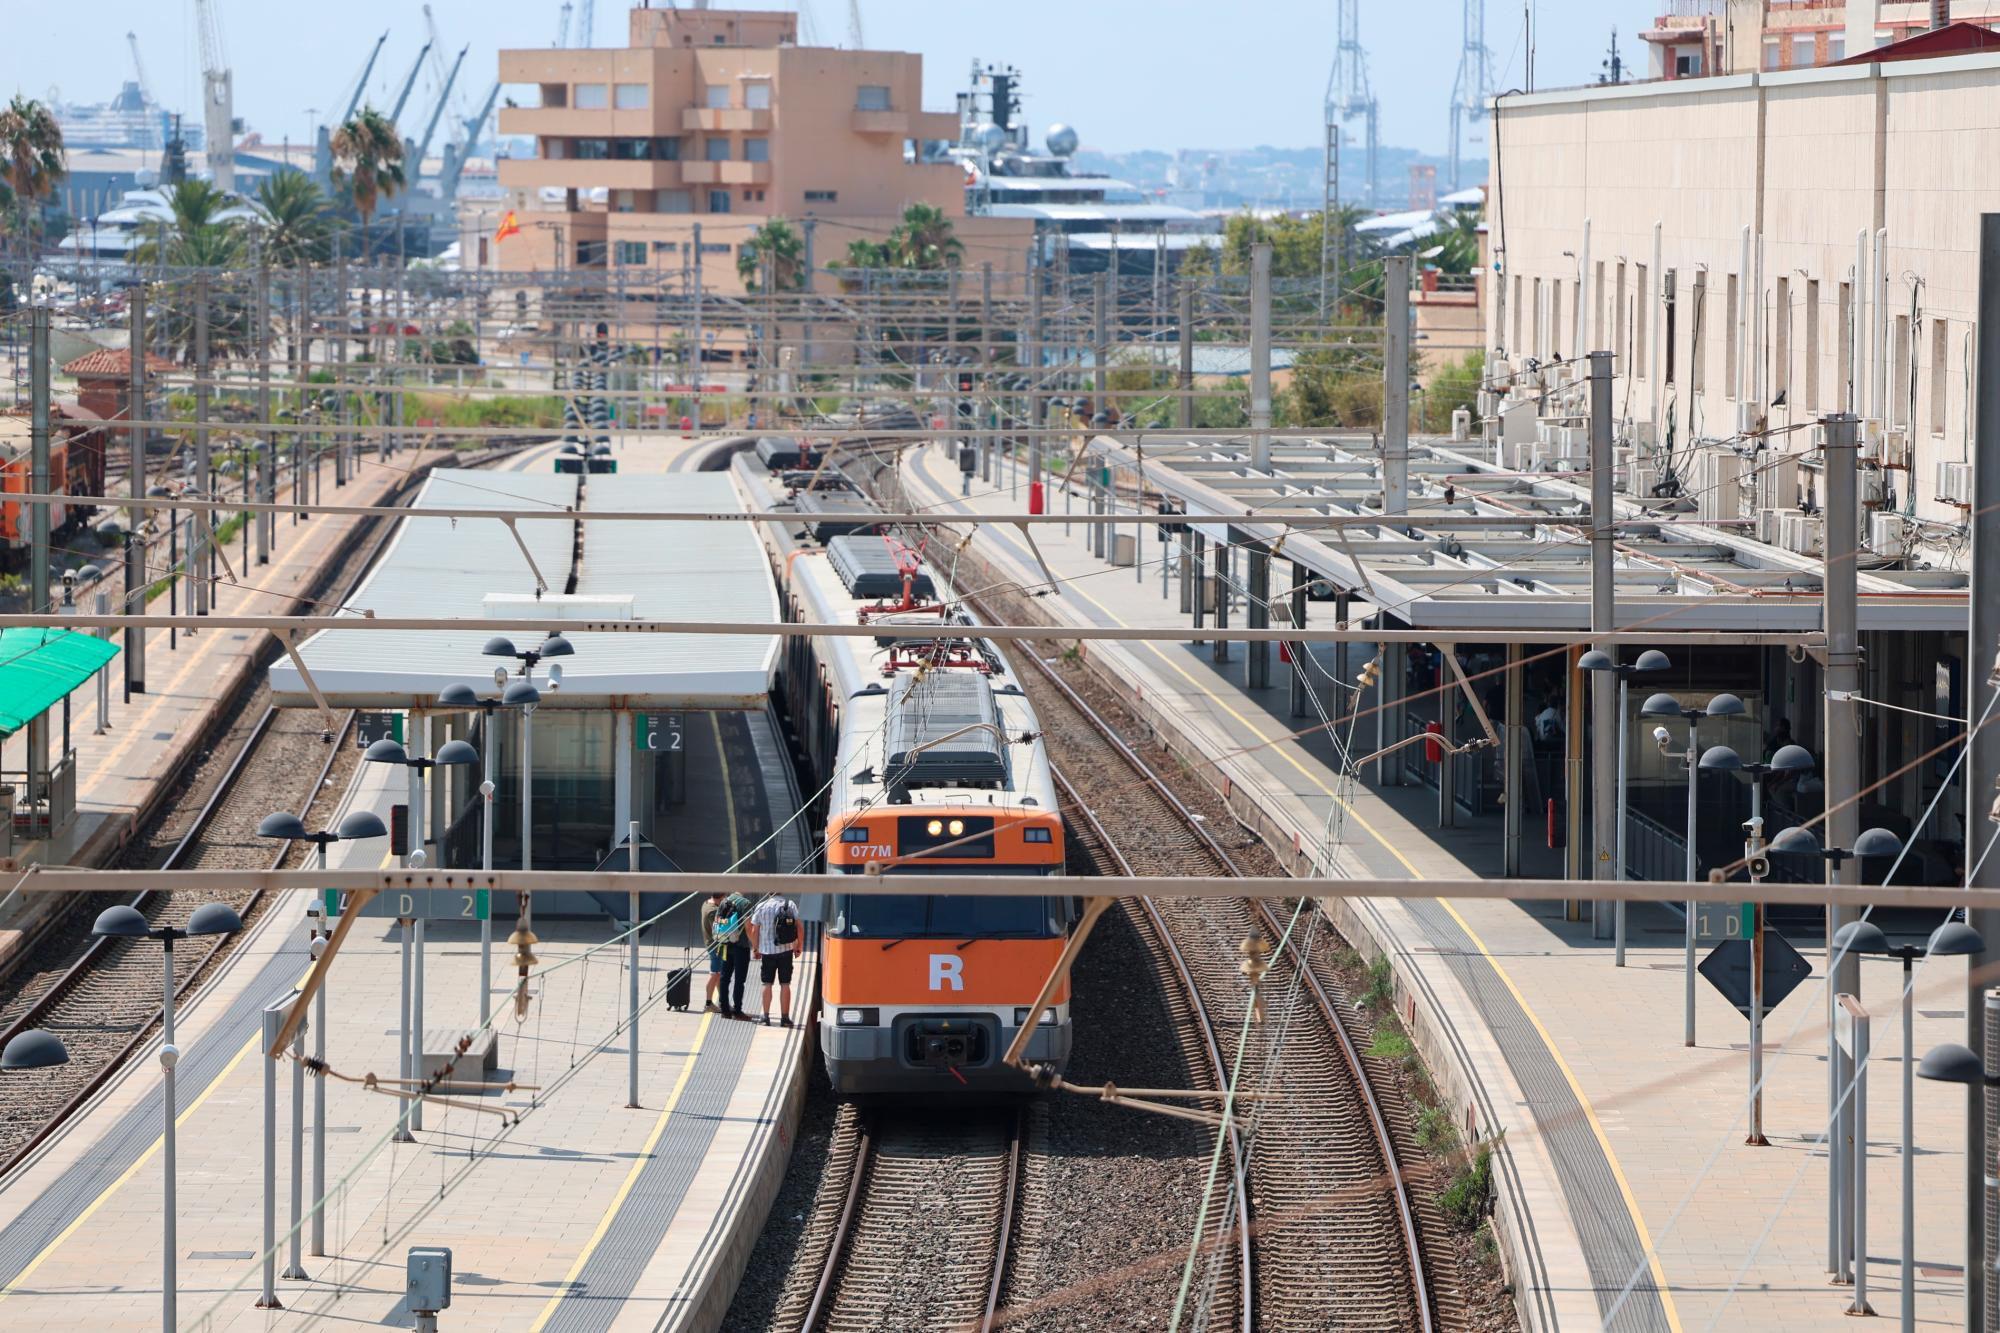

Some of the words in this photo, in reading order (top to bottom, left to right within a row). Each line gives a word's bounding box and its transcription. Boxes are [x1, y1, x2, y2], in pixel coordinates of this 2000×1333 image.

[358, 730, 370, 748] 4
[648, 732, 657, 749] C
[671, 732, 681, 749] 2
[851, 845, 891, 857] 077M
[399, 894, 413, 915] D
[461, 895, 473, 917] 2
[1699, 915, 1712, 936] 1
[1726, 915, 1740, 936] D
[929, 954, 964, 990] R
